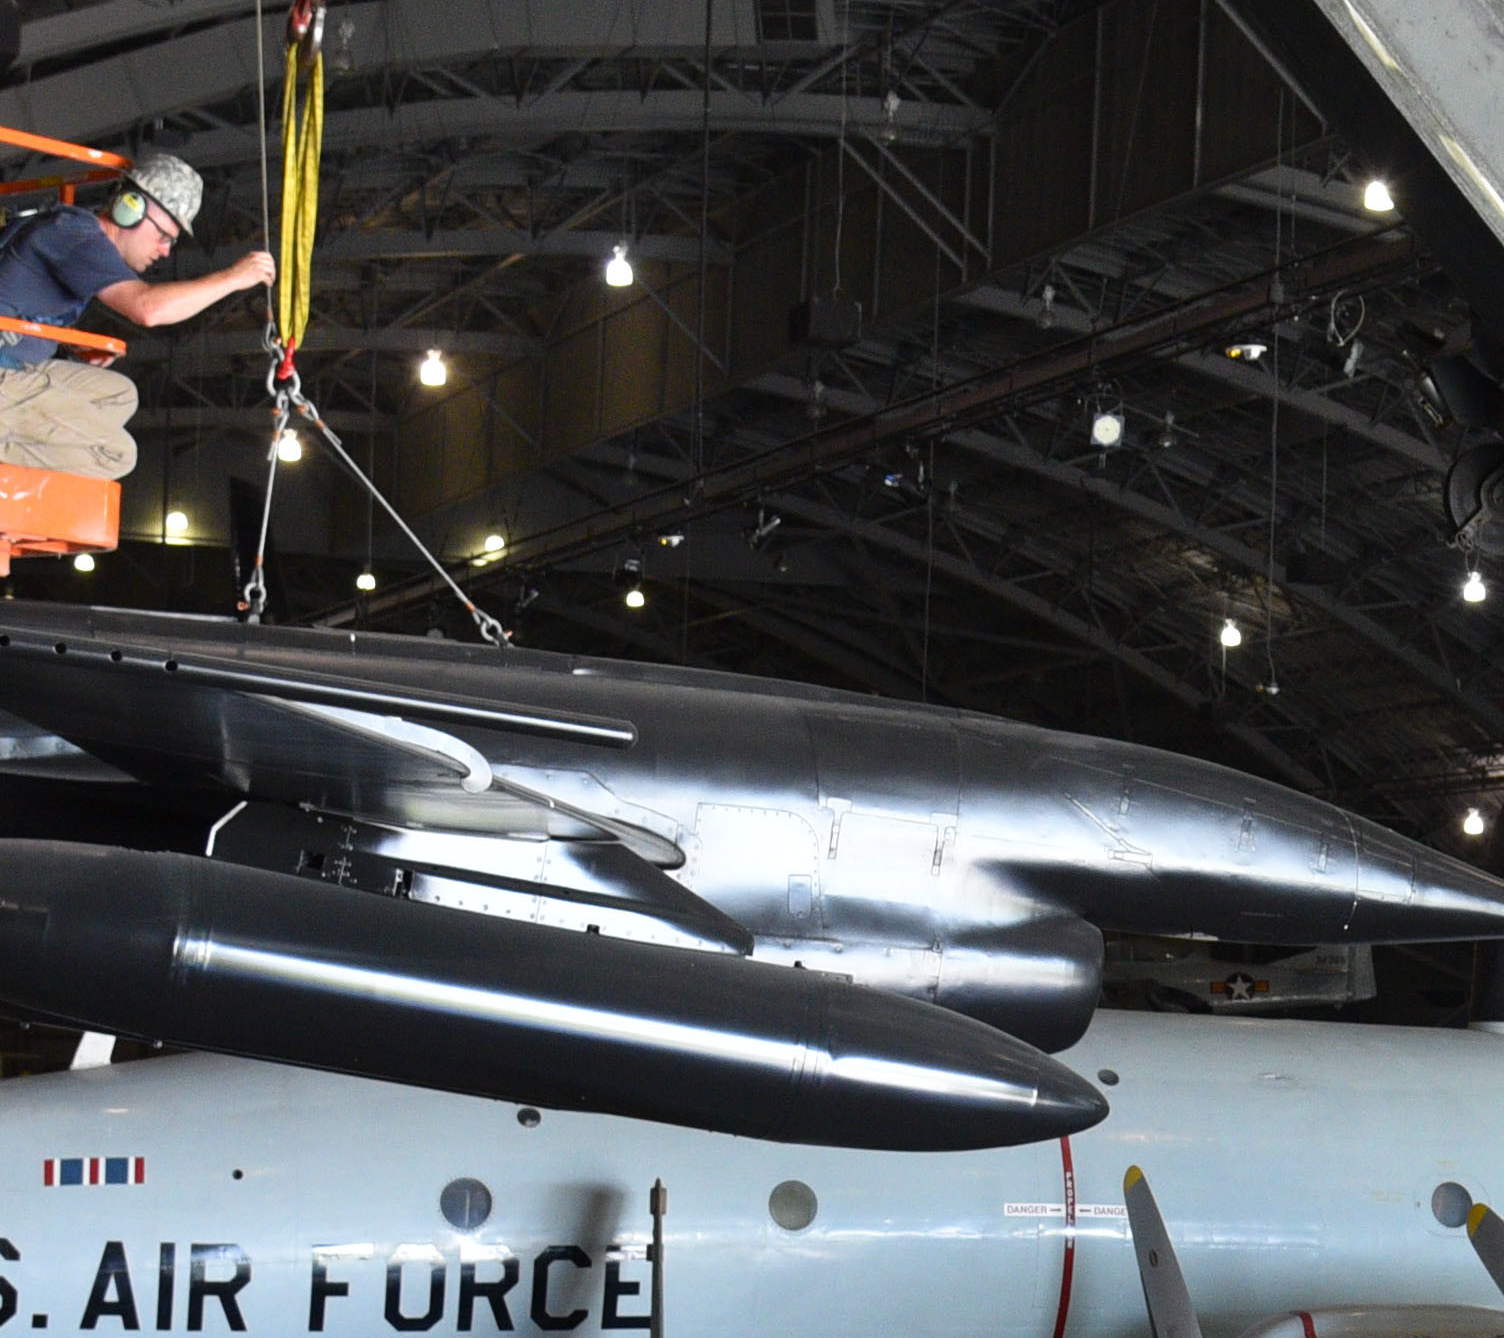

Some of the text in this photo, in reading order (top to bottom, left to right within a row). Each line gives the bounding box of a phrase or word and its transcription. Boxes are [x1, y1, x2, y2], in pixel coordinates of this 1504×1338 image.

[1006, 1204, 1048, 1215] DANGER
[1093, 1206, 1128, 1217] DANGE
[80, 1241, 253, 1332] AIR
[308, 1243, 654, 1333] FORCE
